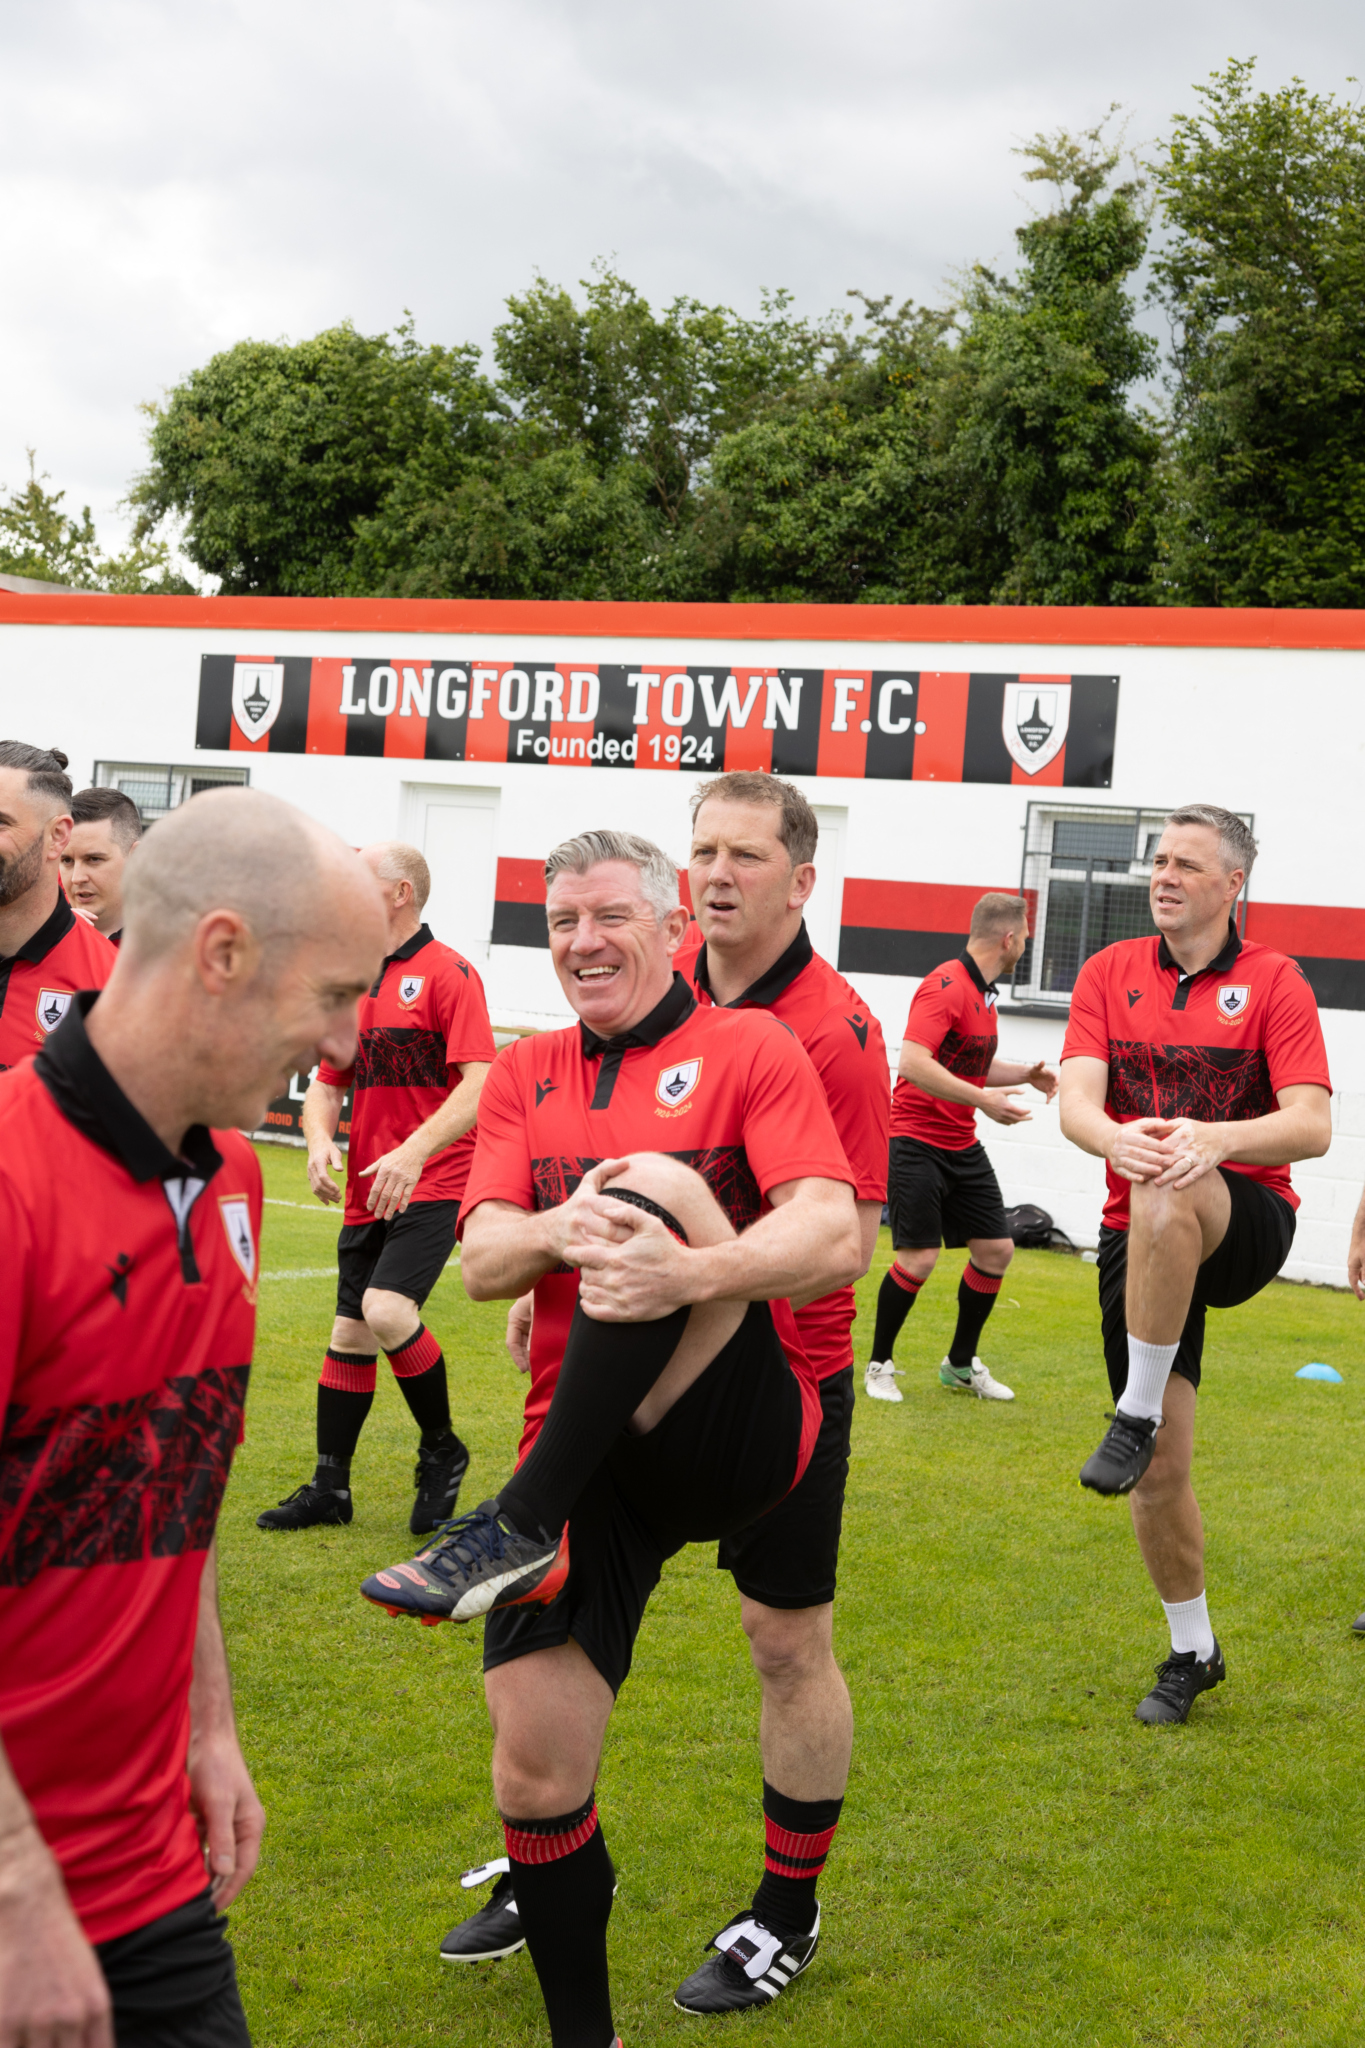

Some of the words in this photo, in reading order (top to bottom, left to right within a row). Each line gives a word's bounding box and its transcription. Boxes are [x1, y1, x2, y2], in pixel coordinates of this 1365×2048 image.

[339, 665, 600, 723] LONGFORD
[627, 673, 803, 730] TOWN
[830, 677, 927, 735] F.C.
[516, 729, 638, 761] Founded
[649, 735, 714, 764] 1924
[654, 1100, 692, 1118] 1924-2024
[731, 1946, 750, 1962] adidas
